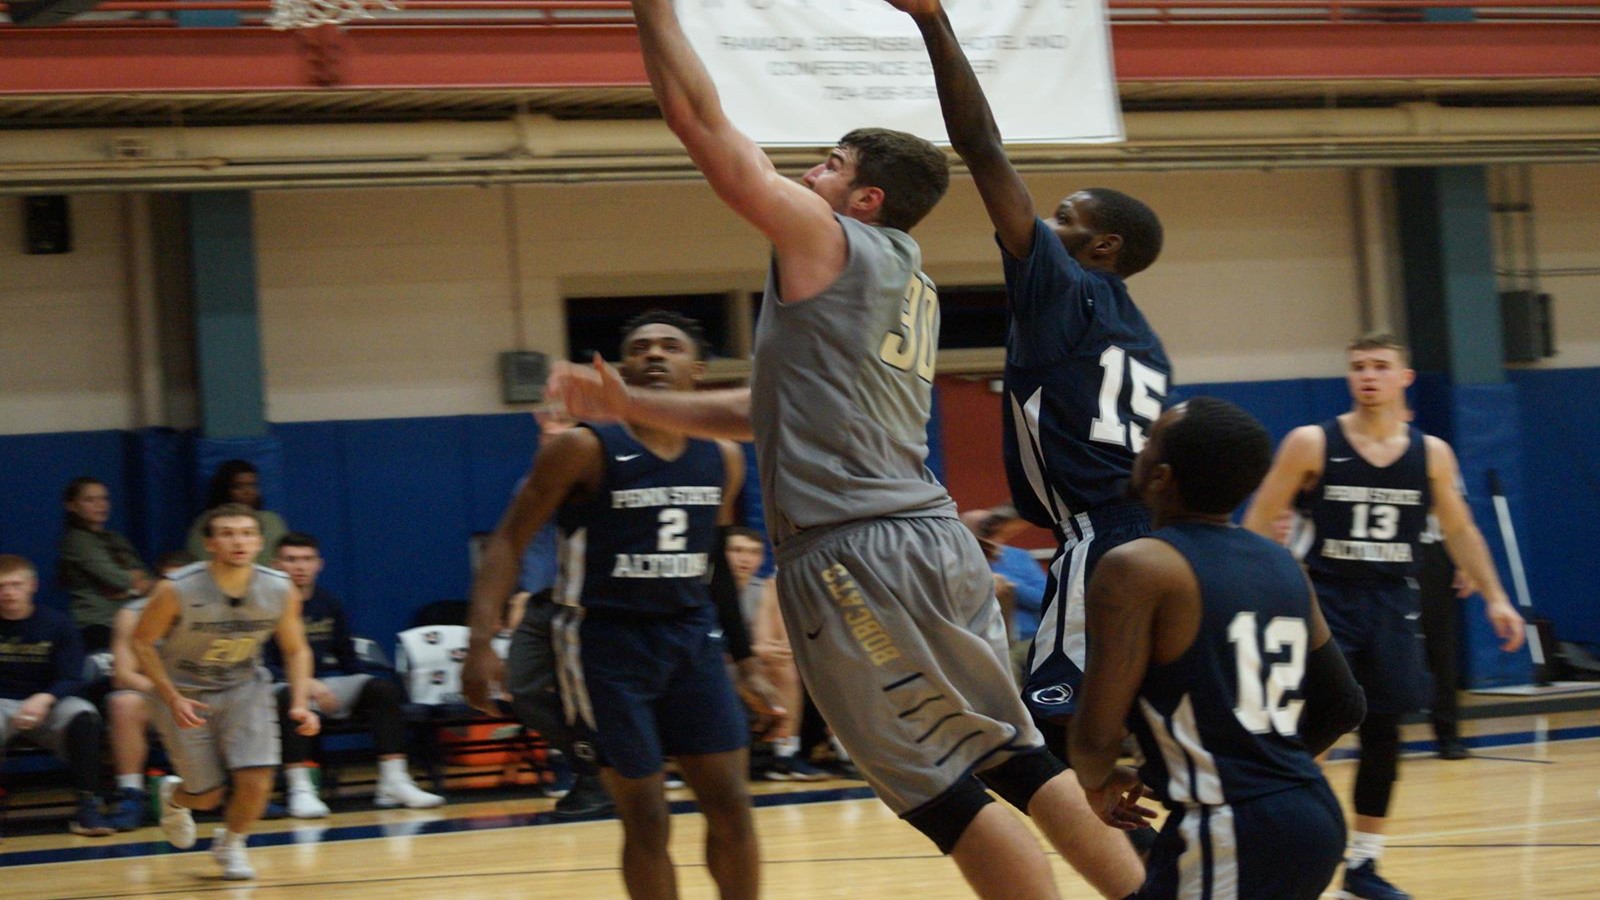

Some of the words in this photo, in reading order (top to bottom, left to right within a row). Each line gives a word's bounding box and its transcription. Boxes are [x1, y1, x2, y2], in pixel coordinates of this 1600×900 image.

[767, 60, 911, 76] CONFERENCE
[813, 35, 928, 51] GREENSBU
[1024, 35, 1069, 50] AND
[880, 272, 938, 384] 30
[1089, 344, 1168, 453] 15
[657, 508, 689, 551] 2
[1350, 503, 1398, 540] 13
[821, 563, 900, 667] BOBCATS
[1227, 611, 1308, 736] 12
